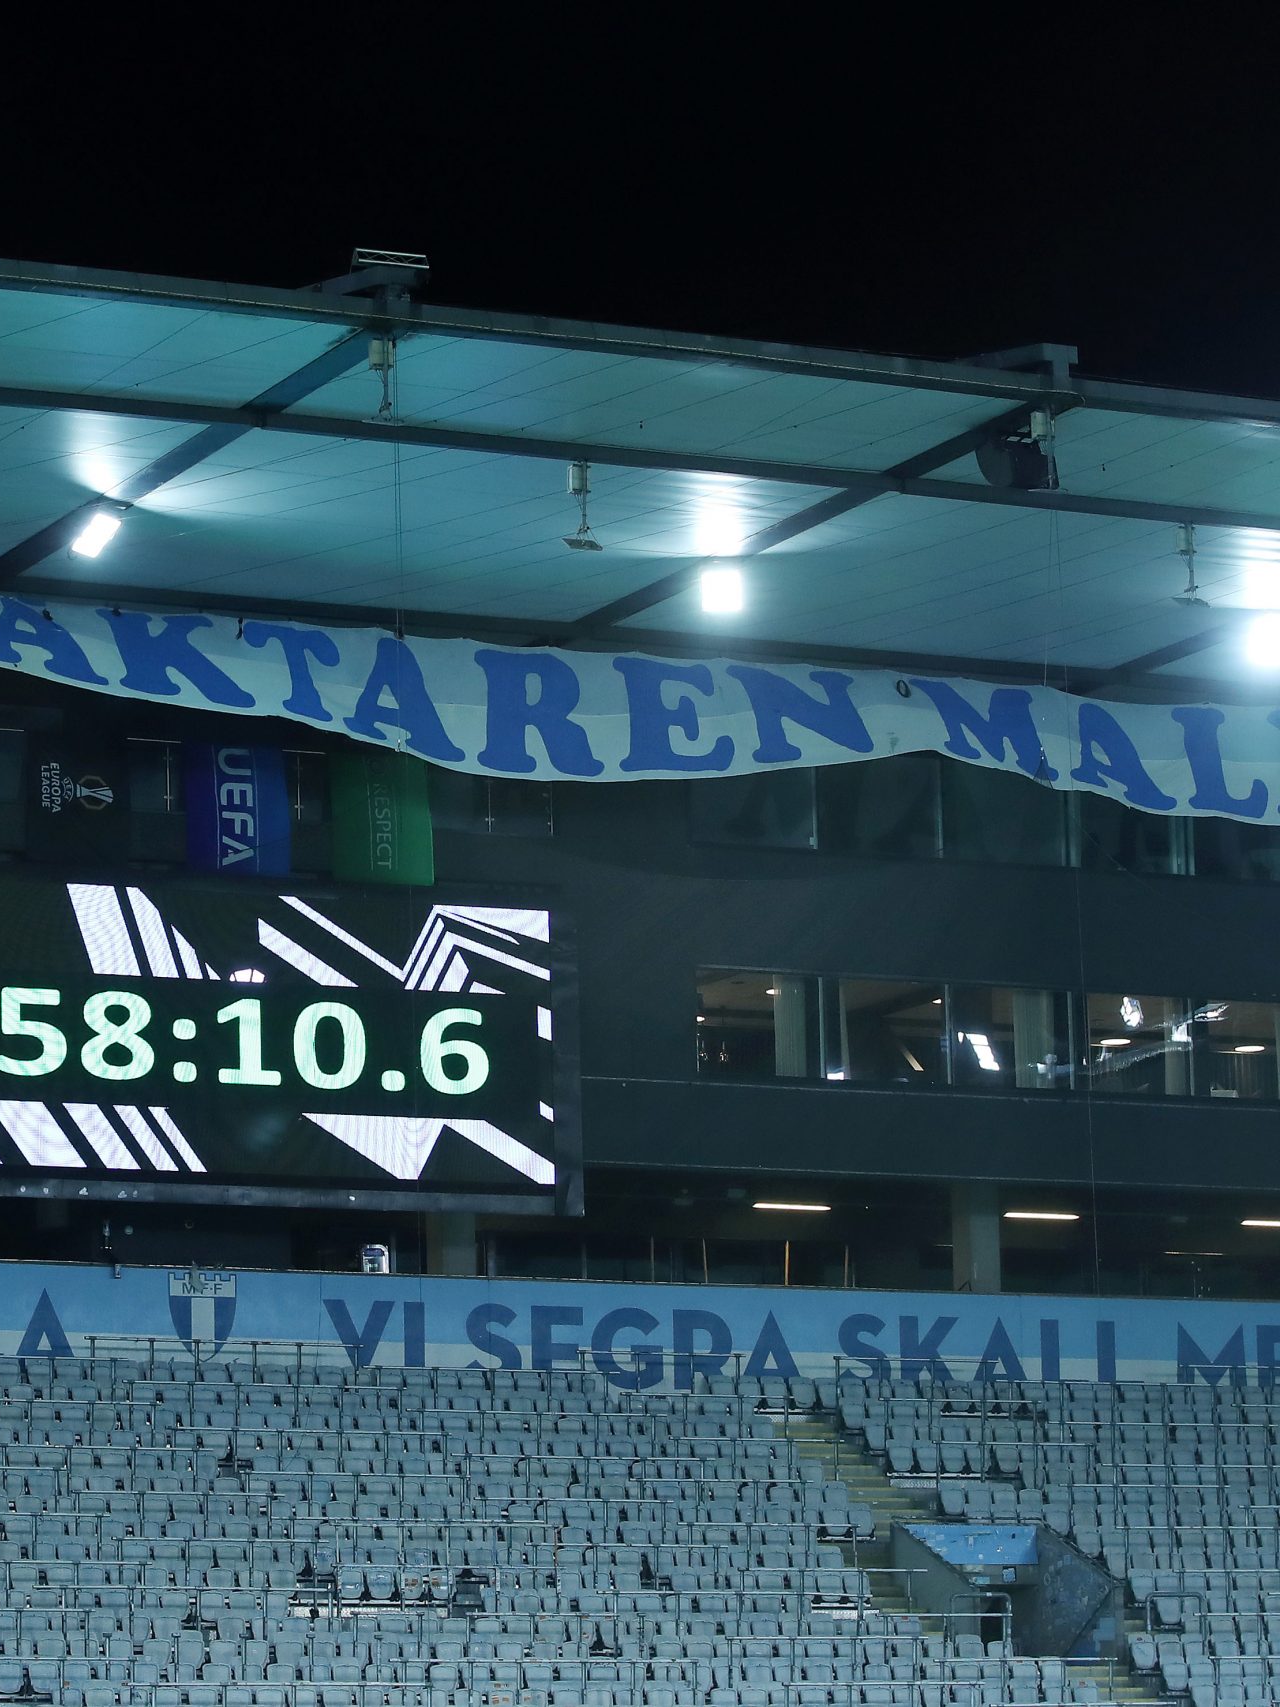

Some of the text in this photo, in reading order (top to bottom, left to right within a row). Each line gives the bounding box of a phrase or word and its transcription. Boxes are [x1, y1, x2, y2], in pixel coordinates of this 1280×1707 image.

[909, 678, 1280, 819] MAL
[41, 765, 51, 808] LEAGUE
[50, 762, 61, 813] EUROPA
[63, 777, 72, 800] UEFA
[218, 748, 255, 866] UEFA
[372, 783, 393, 871] RESPECT
[323, 1299, 425, 1367] VI
